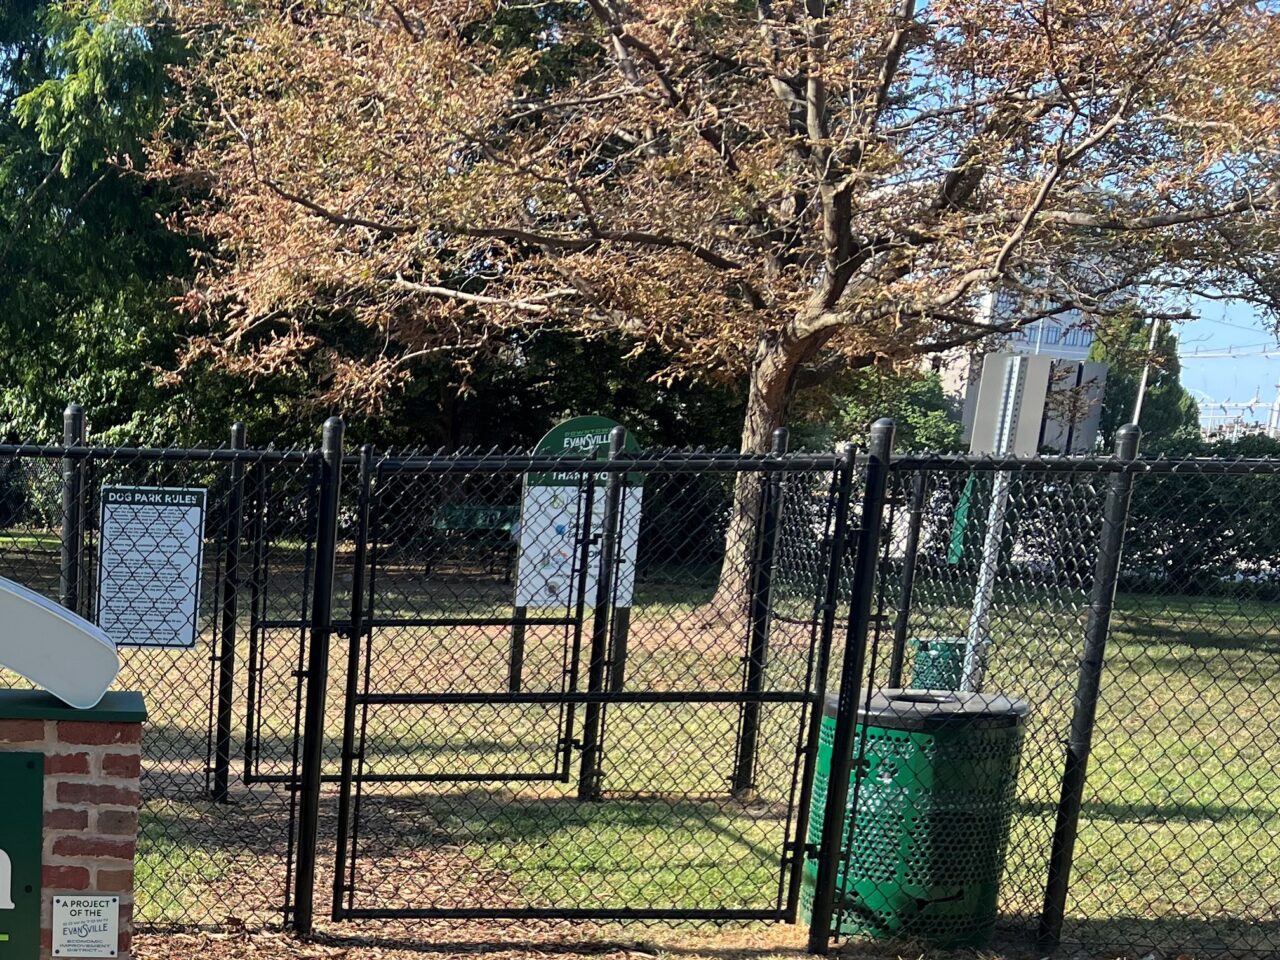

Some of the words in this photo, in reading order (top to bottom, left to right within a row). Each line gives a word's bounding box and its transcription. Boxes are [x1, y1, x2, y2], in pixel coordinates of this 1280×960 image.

[593, 471, 609, 480] YO
[108, 492, 132, 501] DOG
[134, 493, 162, 503] PARK
[164, 494, 197, 504] RULES
[62, 900, 69, 908] A
[70, 900, 110, 908] PROJECT
[69, 909, 83, 917] OF
[84, 909, 102, 917] THE
[62, 923, 108, 938] EVANSVILLE
